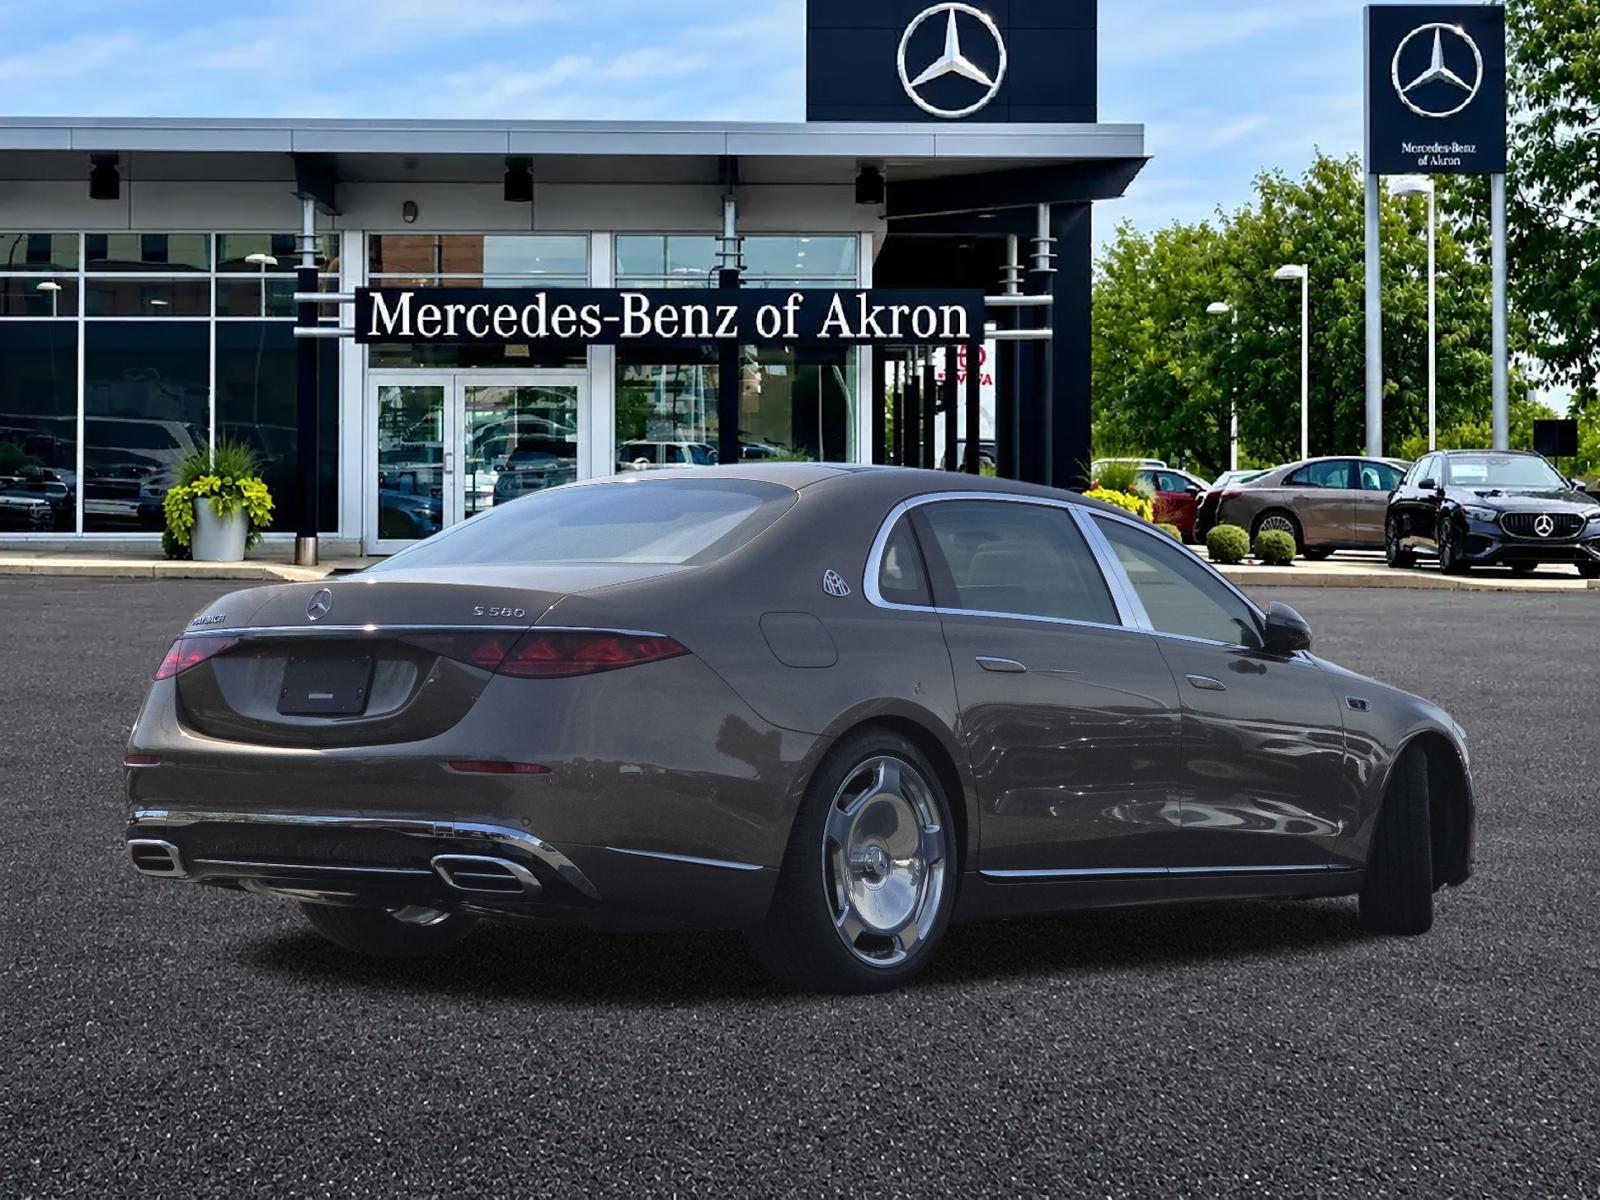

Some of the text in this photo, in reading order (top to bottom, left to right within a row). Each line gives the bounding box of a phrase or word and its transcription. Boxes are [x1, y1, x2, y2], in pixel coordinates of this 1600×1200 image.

[1401, 141, 1477, 154] Mercedes-Benz
[1417, 154, 1461, 166] of Akron
[367, 291, 971, 339] Mercedes-Benz of Akron
[473, 606, 526, 618] S 580
